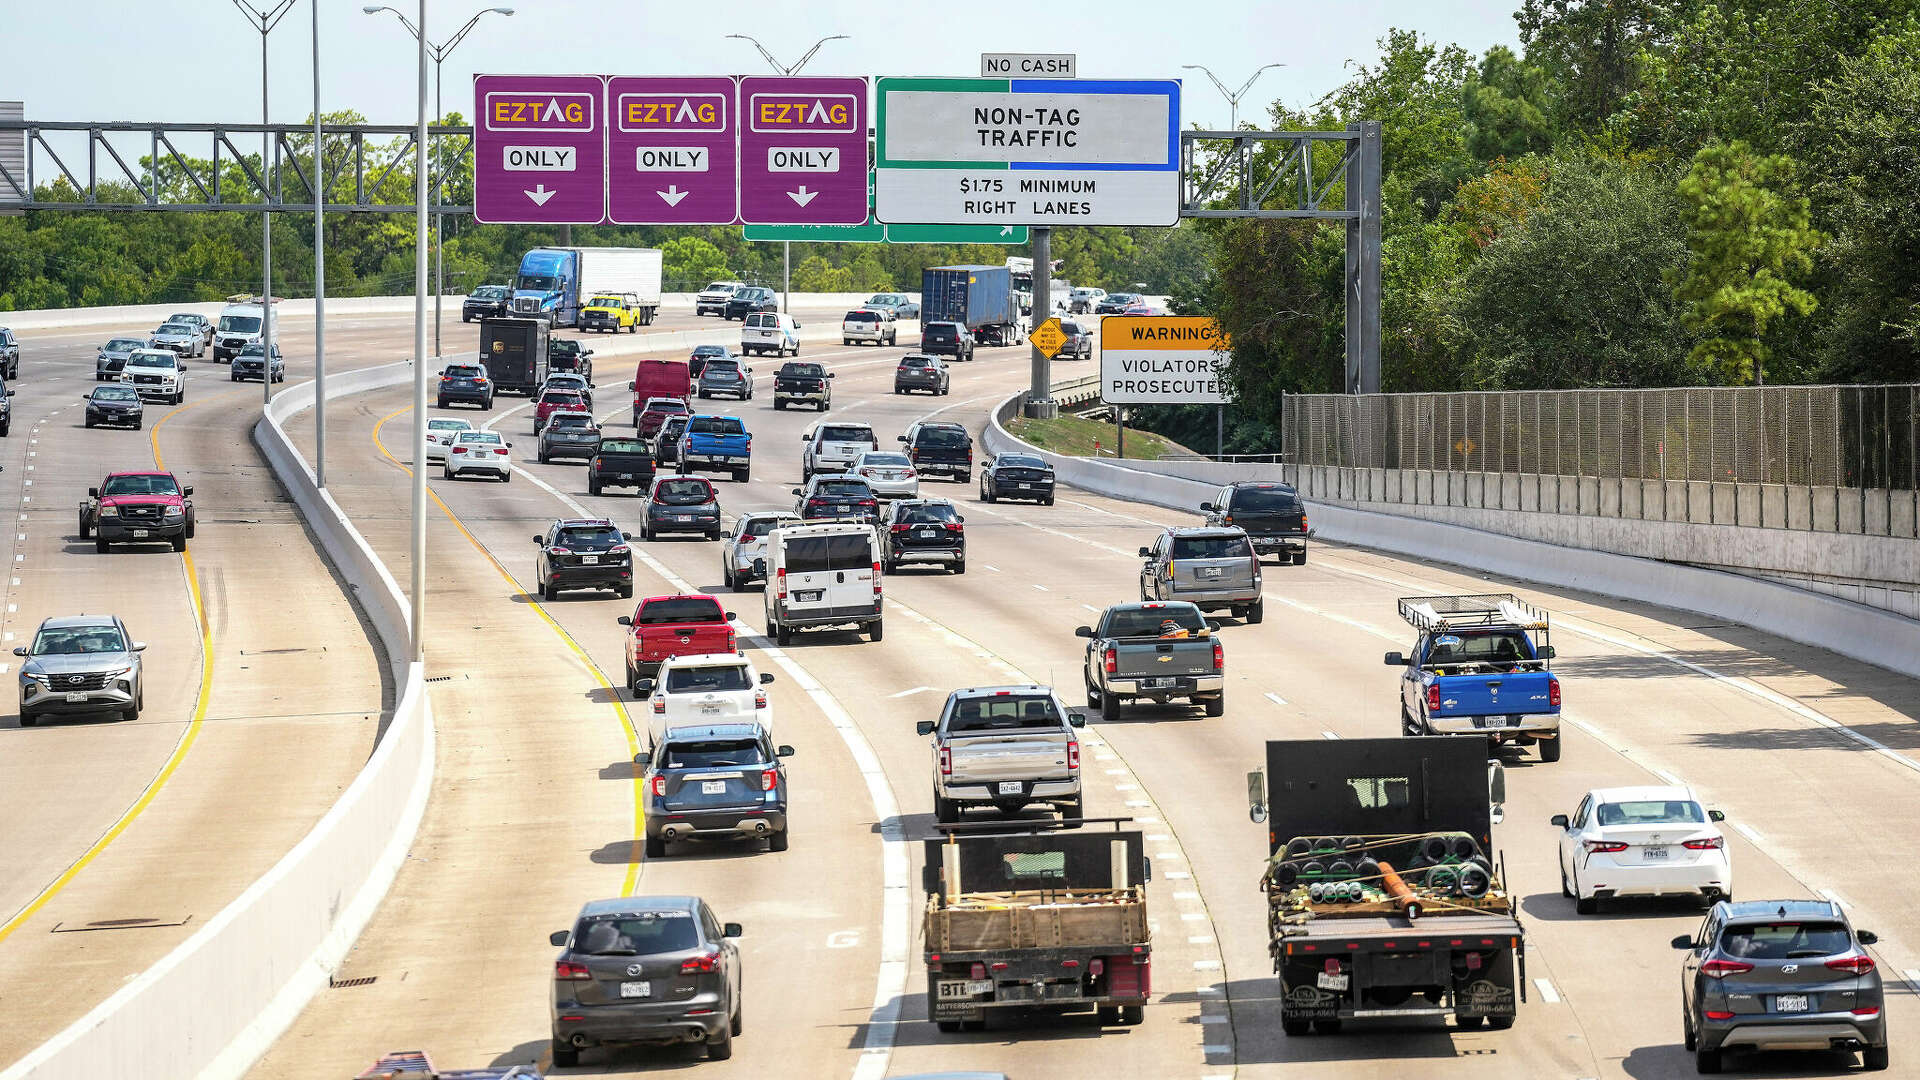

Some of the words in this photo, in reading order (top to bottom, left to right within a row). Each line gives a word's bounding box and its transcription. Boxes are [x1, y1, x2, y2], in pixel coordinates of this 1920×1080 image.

[987, 59, 1011, 73] NO
[1021, 59, 1071, 73] CASH
[495, 97, 583, 123] EZTAG
[628, 98, 716, 123] EZTAG
[760, 99, 848, 124] EZTAG
[974, 107, 1081, 126] NON-TAG
[977, 129, 1078, 148] TRAFFIC
[509, 150, 569, 167] ONLY
[642, 151, 702, 168] ONLY
[774, 151, 833, 168] ONLY
[959, 177, 1003, 194] $1.75
[1020, 179, 1096, 194] MINIMUM
[964, 201, 1016, 215] RIGHT
[1033, 201, 1091, 215] LANES
[1131, 327, 1211, 340] WARNING
[1122, 360, 1218, 373] VIOLATORS
[1113, 380, 1229, 394] PROSECUTED
